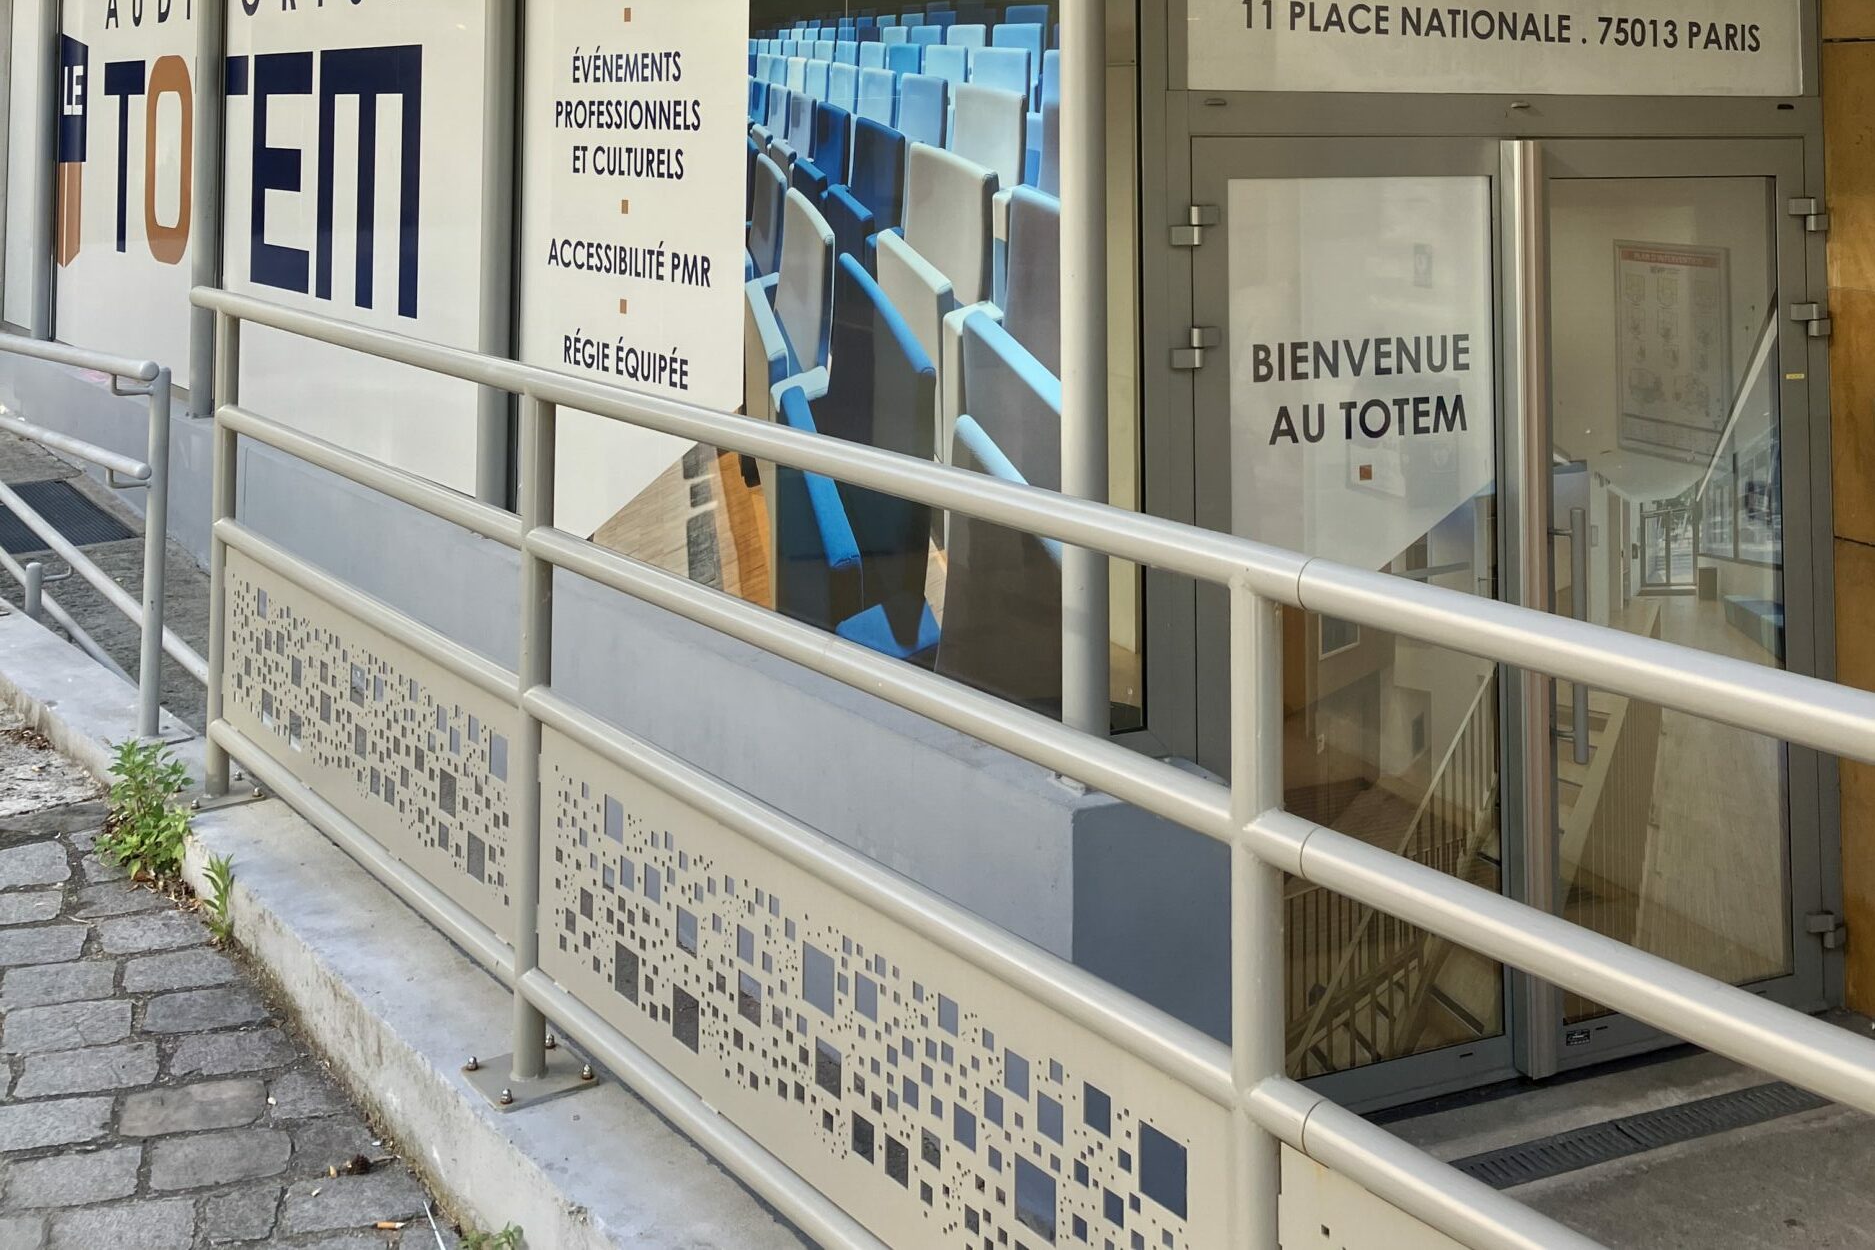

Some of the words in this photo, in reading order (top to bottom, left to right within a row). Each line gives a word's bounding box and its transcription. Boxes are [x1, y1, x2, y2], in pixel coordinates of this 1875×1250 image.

[1288, 0, 1390, 36] PLACE
[1401, 7, 1571, 44] NATIONALE
[1598, 16, 1679, 49] 75013
[1688, 22, 1761, 53] PARIS
[572, 45, 682, 84] ÉVÉNEMENTS
[63, 65, 84, 116] LE
[555, 98, 701, 132] PROFESSIONNELS
[572, 145, 588, 174] ET
[592, 146, 684, 180] CULTURELS
[548, 238, 665, 281] ACCESSIBILITÉ
[670, 252, 711, 288] PMR
[563, 328, 610, 373] RÉGIE
[615, 335, 689, 390] ÉQUIPÉE
[1252, 333, 1471, 383] BIENVENUE
[1268, 403, 1326, 447] AU
[1339, 394, 1468, 441] TOTEM
